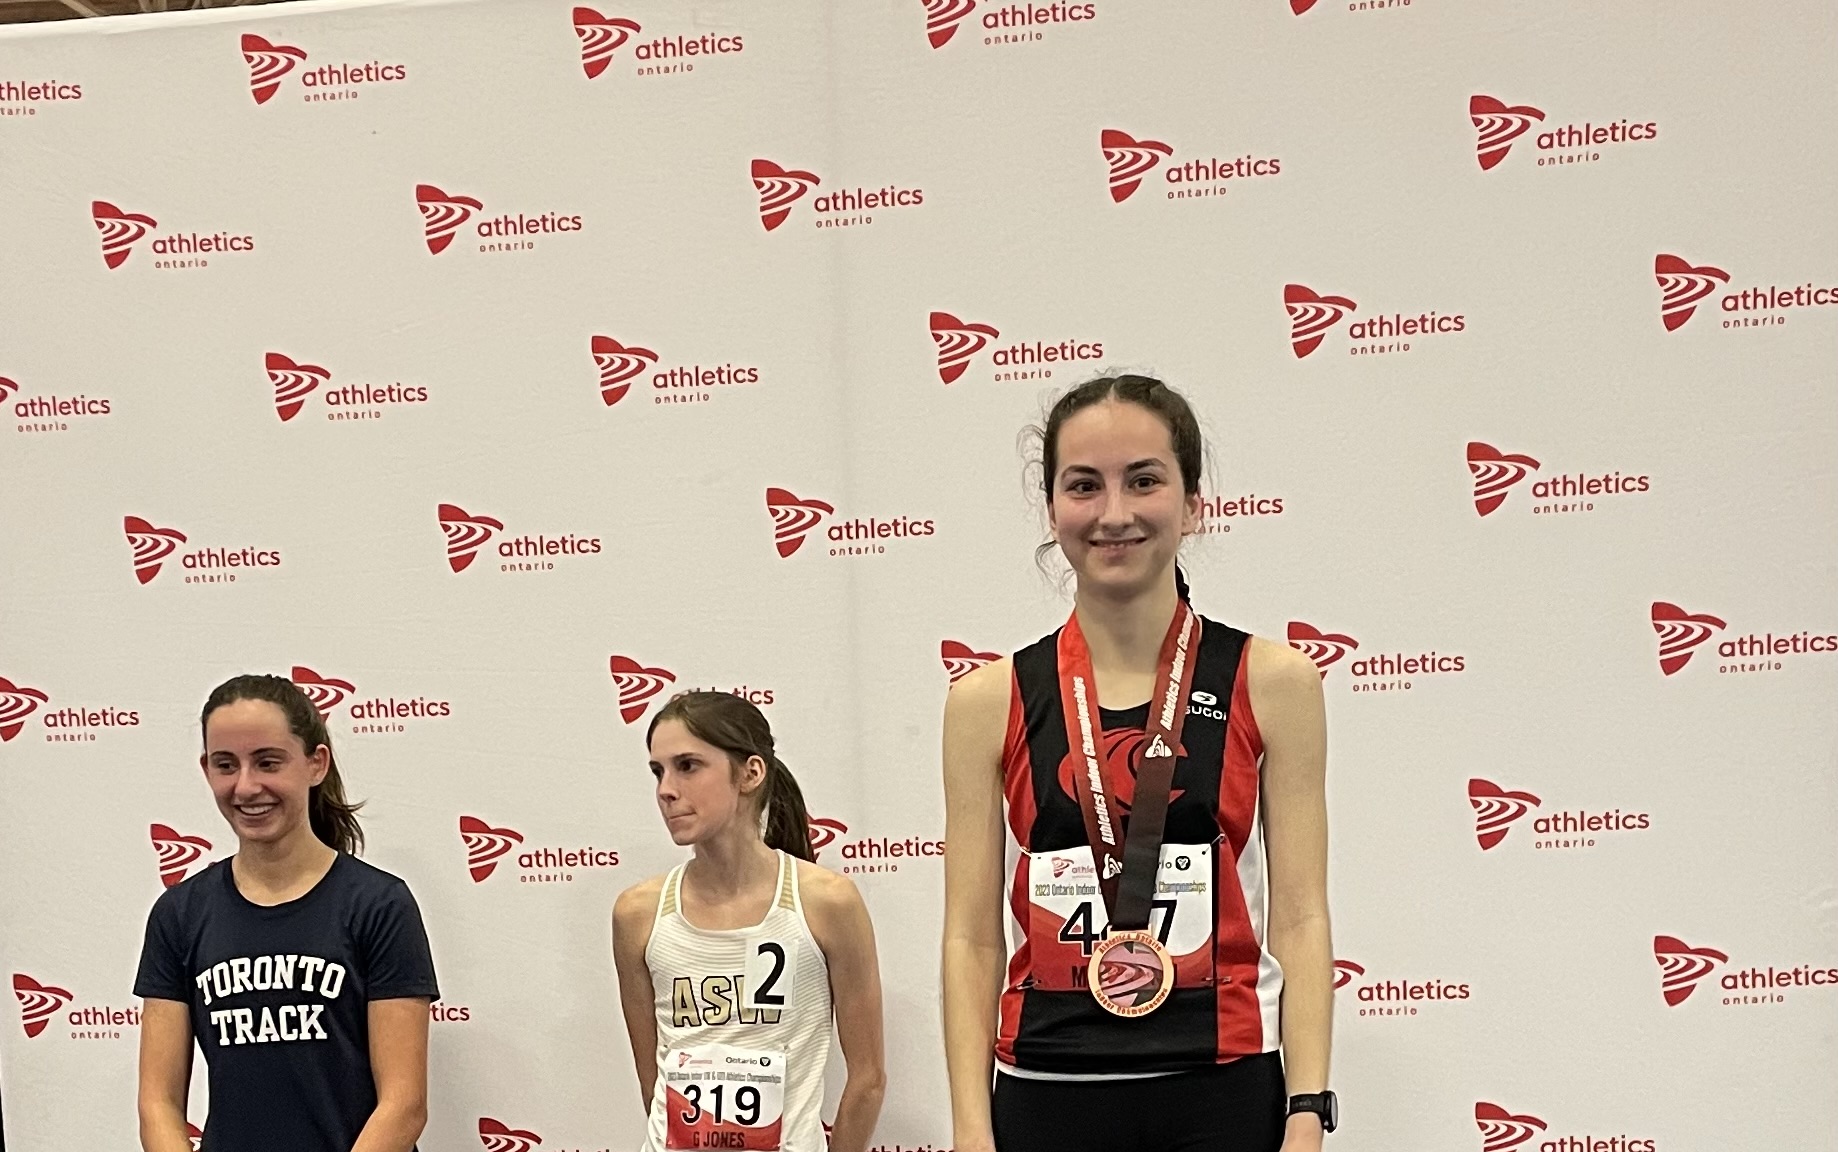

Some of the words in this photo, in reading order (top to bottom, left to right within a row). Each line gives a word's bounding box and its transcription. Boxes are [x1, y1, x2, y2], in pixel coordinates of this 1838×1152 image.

[983, 3, 1095, 29] athletics
[636, 32, 743, 60] athletics
[984, 31, 1042, 45] ontario
[302, 61, 405, 87] athletics
[638, 62, 693, 76] ontario
[0, 80, 81, 101] thletics
[304, 89, 358, 102] ontario
[0, 106, 35, 115] tario
[1537, 119, 1656, 149] athletics
[1166, 155, 1280, 183] athletics
[1538, 151, 1599, 166] ontario
[814, 185, 923, 212] athletics
[1168, 185, 1226, 199] ontario
[478, 212, 582, 237] athletics
[816, 215, 872, 228] ontario
[152, 232, 253, 254] athletics
[480, 240, 533, 252] ontario
[155, 258, 207, 268] ontario
[1722, 283, 1838, 311] athletics
[1349, 311, 1465, 339] athletics
[1723, 315, 1785, 328] ontario
[993, 339, 1103, 366] athletics
[1350, 342, 1410, 355] ontario
[653, 364, 758, 389] athletics
[995, 368, 1051, 381] ontario
[326, 382, 427, 405] athletics
[655, 392, 709, 404] ontario
[15, 395, 110, 417] athletics
[328, 409, 381, 420] ontario
[18, 421, 67, 432] ontario
[1532, 472, 1649, 498] athletics
[1199, 494, 1284, 517] hletics
[1533, 501, 1593, 514] ontario
[828, 516, 934, 541] athletics
[499, 534, 601, 557] athletics
[830, 544, 885, 556] ontario
[182, 546, 280, 568] athletics
[501, 561, 553, 572] ontario
[185, 573, 235, 583] ontario
[1718, 631, 1838, 657] athletics
[1351, 651, 1465, 676] athletics
[1720, 660, 1781, 673] ontario
[1353, 680, 1411, 692] ontario
[44, 707, 139, 727] athletics
[350, 697, 450, 719] athletics
[46, 732, 95, 742] ontario
[353, 722, 404, 733] ontario
[1534, 809, 1649, 833] athletics
[841, 836, 945, 860] athletics
[1535, 837, 1595, 849] ontario
[518, 847, 619, 868] athletics
[520, 872, 572, 882] ontario
[843, 863, 897, 874] ontario
[1060, 900, 1177, 955] 47
[196, 955, 346, 1006] TORONTO
[754, 942, 785, 1005] 2
[1721, 965, 1838, 990] athletics
[1358, 980, 1469, 1001] athletics
[1723, 993, 1784, 1005] ontario
[69, 1006, 139, 1025] athleti
[1359, 1006, 1417, 1016] ontario
[71, 1030, 120, 1039] ontario
[210, 1004, 328, 1046] TRACK
[682, 1084, 761, 1126] 319
[703, 1131, 745, 1148] JONES
